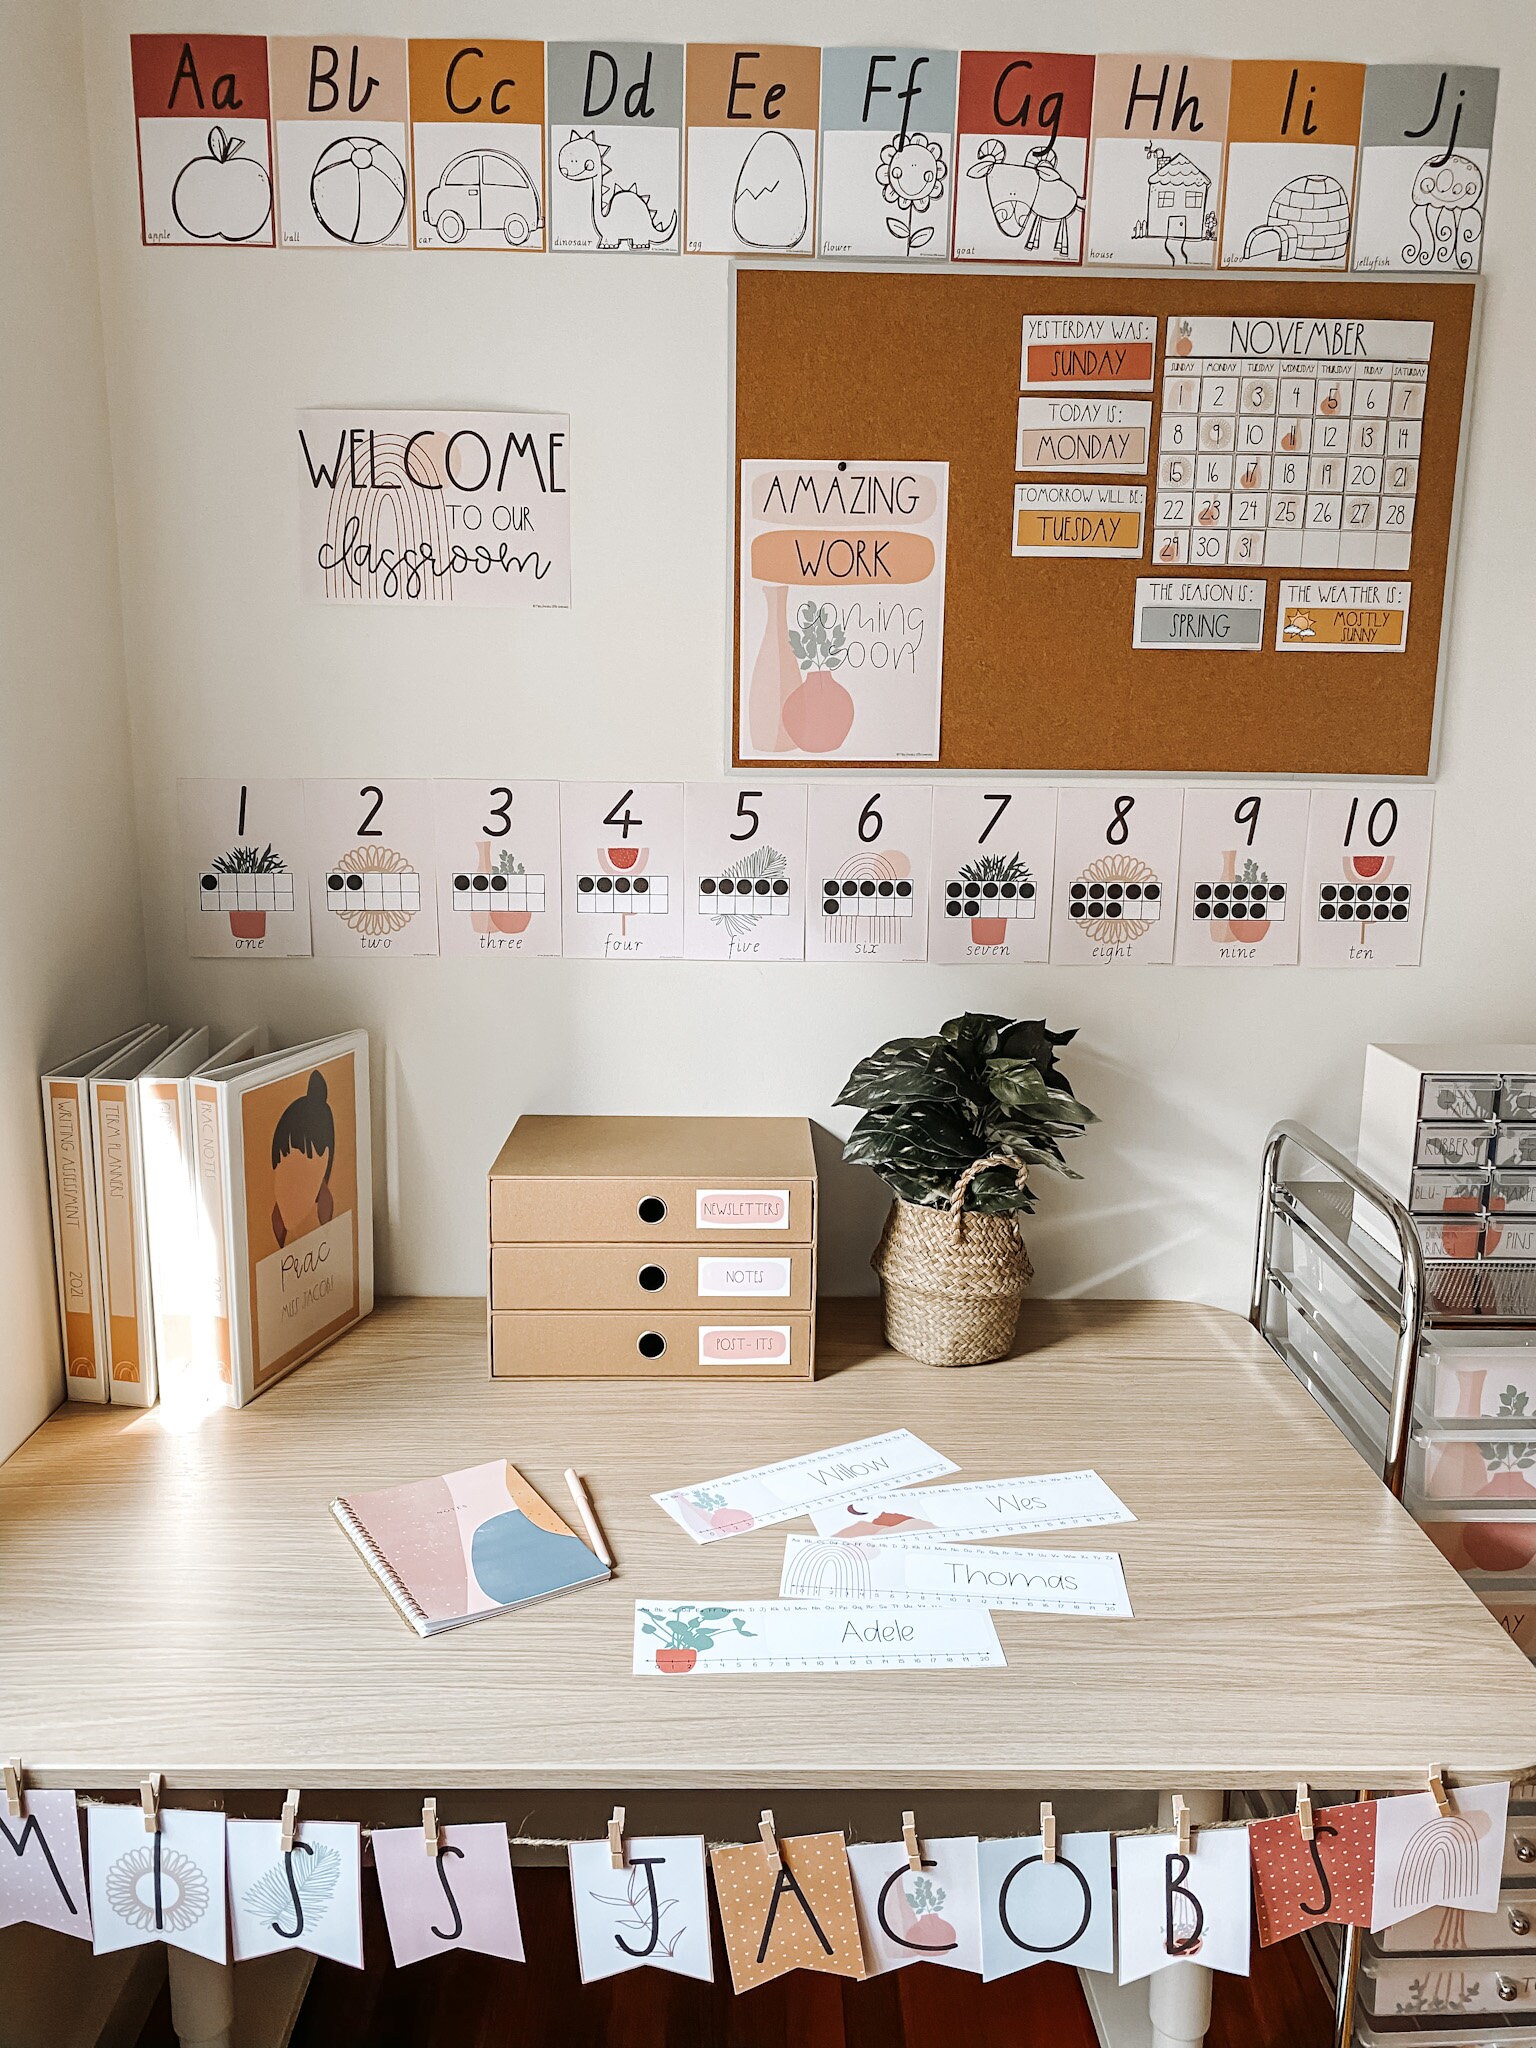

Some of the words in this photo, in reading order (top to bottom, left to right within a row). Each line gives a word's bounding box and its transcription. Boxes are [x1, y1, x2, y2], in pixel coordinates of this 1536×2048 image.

[167, 42, 243, 110] Aa
[446, 47, 515, 115] Cc
[583, 50, 655, 118] Dd
[726, 52, 786, 120] Ee
[862, 55, 929, 153] Ff
[993, 60, 1064, 157] Gg
[1124, 64, 1203, 132] Hh
[1404, 72, 1466, 168] Jj
[147, 230, 171, 241] apple
[283, 231, 300, 243] ball
[554, 238, 593, 247] dinosaur
[688, 241, 702, 253] egg
[823, 241, 852, 253] flower
[956, 246, 975, 259] goat
[1090, 250, 1113, 259] house
[1223, 255, 1244, 268] igloo
[1355, 257, 1390, 270] jellyfish
[1028, 320, 1104, 340] YESTERDAY
[1111, 321, 1149, 340] WAS:
[1230, 320, 1367, 356] NOVEMBER
[1051, 349, 1126, 376] SUNDAY
[1170, 362, 1195, 372] SUNDAY
[1206, 362, 1237, 372] MONDAY
[1247, 363, 1274, 372] TUESDAY
[1281, 364, 1315, 373] WEDNESDAY
[1321, 364, 1352, 374] THURSDAY
[1363, 365, 1384, 375] FRIDAY
[1393, 367, 1425, 377] SATURDAY
[1178, 385, 1183, 405] 1
[1212, 386, 1225, 406] 2
[1252, 386, 1263, 406] 3
[1292, 387, 1300, 408] 4
[1328, 388, 1339, 409] 5
[1366, 388, 1375, 410] 6
[1403, 390, 1412, 411] 7
[1048, 403, 1101, 423] TODAY
[1106, 404, 1122, 423] IS:
[1036, 434, 1130, 461] MONDAY
[1174, 424, 1183, 444] 8
[1213, 425, 1220, 445] 9
[1247, 425, 1264, 445] 10
[1290, 425, 1296, 446] 11
[1324, 426, 1337, 447] 12
[1361, 427, 1373, 448] 13
[1399, 428, 1408, 449] 14
[299, 429, 566, 493] WELCOME
[1169, 462, 1182, 483] 15
[1207, 462, 1219, 483] 16
[1246, 462, 1258, 483] 17
[1283, 463, 1295, 484] 18
[1322, 465, 1332, 485] 19
[1351, 465, 1376, 486] 20
[1393, 467, 1407, 487] 21
[763, 475, 920, 515] AMAZING
[1018, 488, 1093, 504] TOMORROW
[1098, 489, 1124, 504] WILL
[1129, 489, 1143, 504] BE:
[445, 504, 482, 530] TO
[492, 505, 535, 532] OUR
[1163, 500, 1184, 520] 22
[1200, 501, 1221, 521] 23
[1239, 501, 1258, 521] 24
[1275, 501, 1296, 522] 25
[1312, 502, 1332, 523] 26
[1350, 503, 1370, 524] 27
[1385, 505, 1405, 525] 28
[1036, 516, 1121, 542] TUESDAY
[318, 516, 551, 598] classroom
[795, 539, 892, 578] WORK
[1161, 536, 1179, 557] 29
[1196, 537, 1220, 557] 30
[1239, 537, 1252, 558] 31
[1150, 583, 1173, 601] THE
[1180, 584, 1233, 602] SEASON
[1238, 584, 1253, 602] IS:
[1288, 585, 1311, 603] THE
[1318, 586, 1381, 603] WEATHER
[1386, 586, 1402, 604] IS:
[796, 601, 925, 654] coming
[1169, 614, 1230, 638] SPRING
[1334, 611, 1390, 627] MOSTLY
[1341, 627, 1378, 642] SUNNY
[828, 641, 916, 674] soon
[238, 785, 247, 836] 1
[357, 785, 384, 836] 2
[482, 787, 513, 837] 3
[602, 789, 643, 839] 4
[729, 791, 763, 841] 5
[858, 793, 883, 843] 6
[978, 794, 1012, 844] 7
[1106, 795, 1135, 845] 8
[1234, 796, 1262, 846] 9
[1343, 797, 1398, 848] 10
[235, 937, 265, 949] one
[360, 935, 393, 949] two
[479, 931, 523, 949] three
[603, 933, 643, 958] four
[728, 934, 761, 959] five
[855, 940, 879, 954] six
[966, 944, 1011, 956] seven
[1092, 939, 1133, 965] eight
[1219, 945, 1257, 960] nine
[1349, 942, 1375, 960] ten
[57, 1101, 75, 1151] WRITING
[105, 1104, 121, 1138] TERM
[201, 1103, 213, 1134] PRAC
[1425, 1138, 1477, 1155] RUBBERS
[107, 1143, 125, 1199] PLANNERS
[62, 1156, 80, 1229] ASSESSMENT
[703, 1202, 780, 1216] NEWSLETTERS
[1506, 1232, 1534, 1250] PINS
[69, 1271, 84, 1298] 2021
[726, 1270, 764, 1284] NOTES
[806, 1456, 890, 1486] Willow
[985, 1494, 1047, 1513] Wes
[944, 1562, 1078, 1590] Thomas
[841, 1619, 914, 1643] Adele
